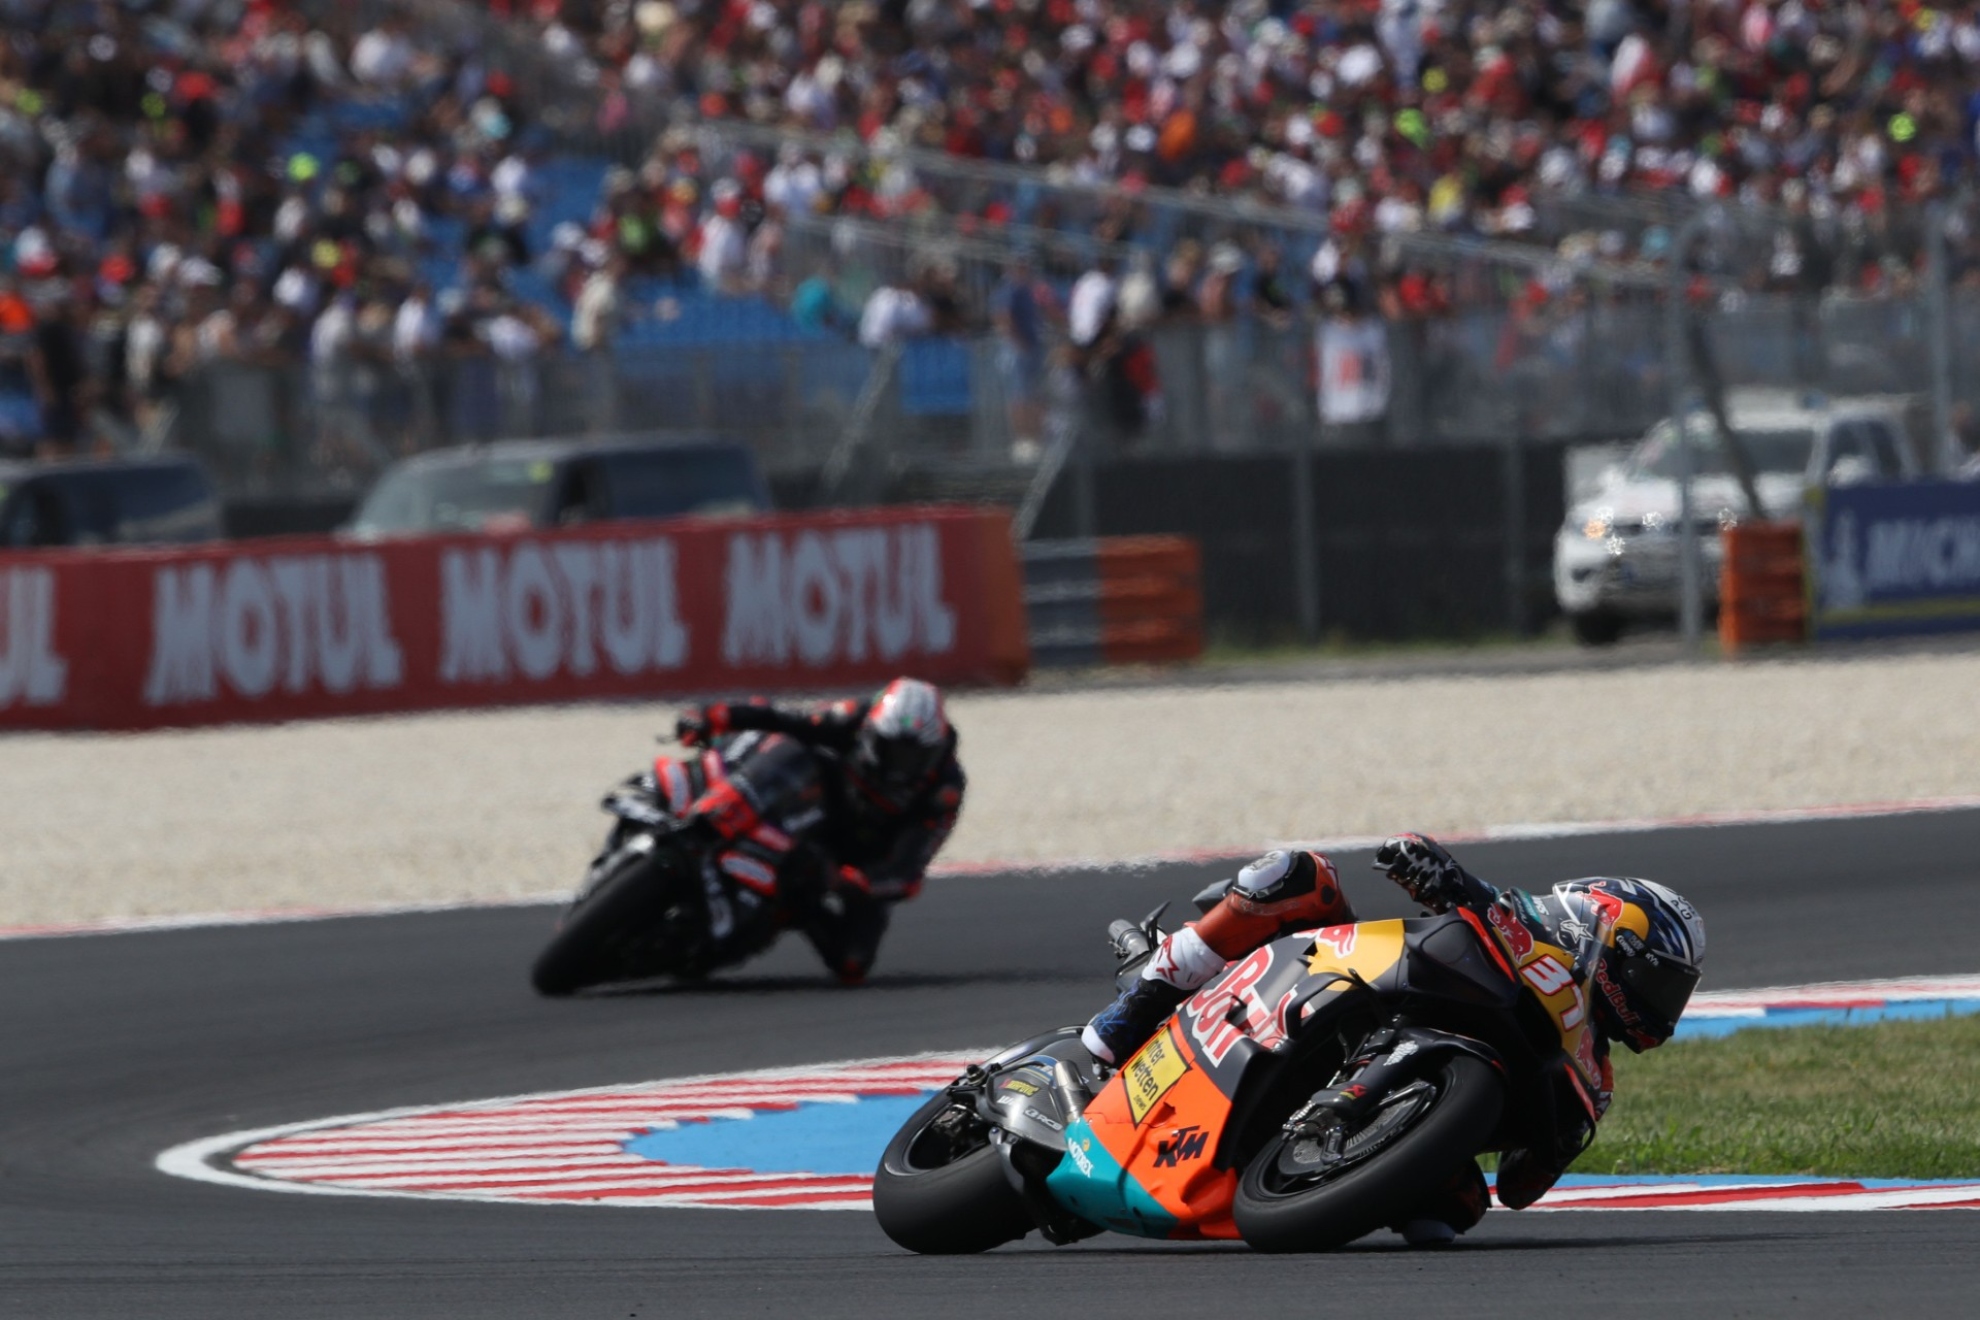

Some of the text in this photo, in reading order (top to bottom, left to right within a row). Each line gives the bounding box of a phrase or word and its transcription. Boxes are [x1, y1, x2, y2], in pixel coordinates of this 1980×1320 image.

[144, 552, 403, 706] MOTUL
[440, 537, 689, 683] MOTUL
[723, 523, 956, 667] MOTUL
[1519, 952, 1586, 1033] 37
[1131, 1055, 1159, 1101] wetten
[1153, 1125, 1209, 1168] KTM
